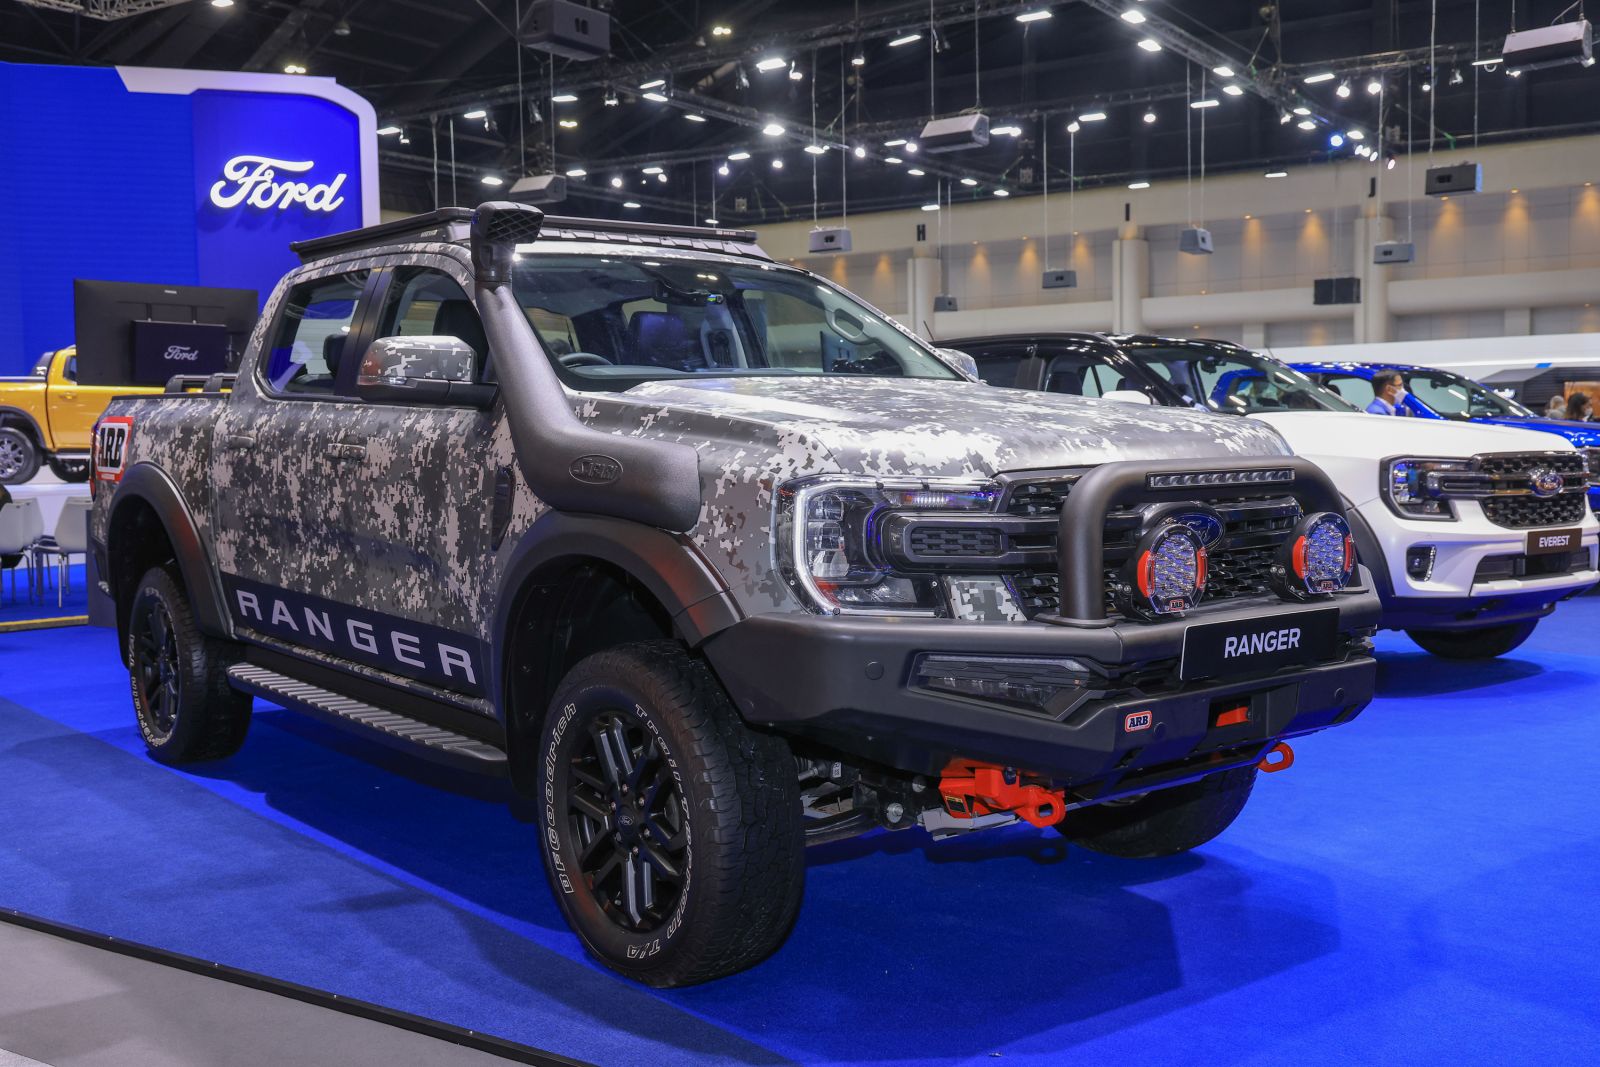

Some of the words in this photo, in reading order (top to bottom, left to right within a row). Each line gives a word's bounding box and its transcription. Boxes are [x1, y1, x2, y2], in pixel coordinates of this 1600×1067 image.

[210, 155, 347, 212] Ford
[917, 224, 926, 241] H
[164, 345, 199, 361] Ford
[1539, 535, 1570, 547] EVEREST
[236, 589, 476, 685] RANGER
[1224, 627, 1301, 659] RANGER
[1129, 715, 1149, 728] ARB
[545, 702, 577, 894] BFGoodrich
[627, 938, 661, 959] T/A
